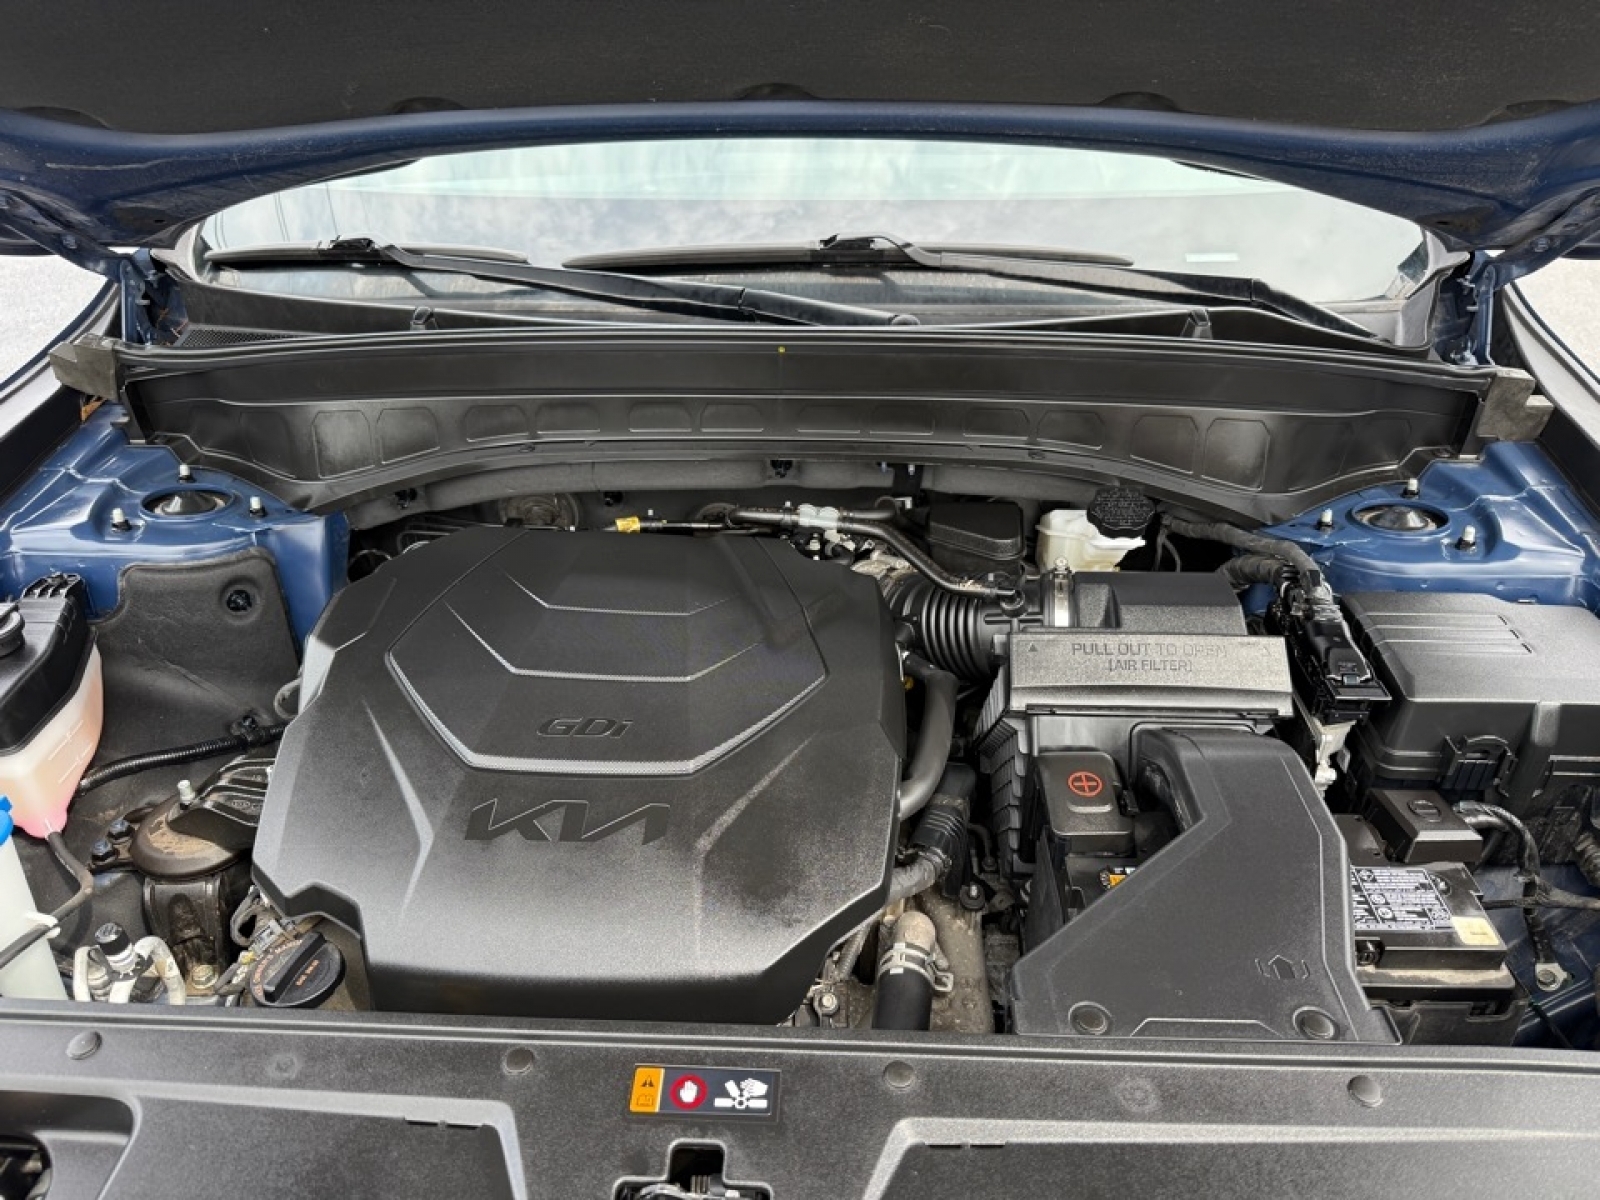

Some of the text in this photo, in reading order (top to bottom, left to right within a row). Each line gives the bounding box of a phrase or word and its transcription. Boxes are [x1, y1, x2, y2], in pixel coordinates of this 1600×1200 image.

[1071, 643, 1227, 658] PULL OUT TO OPEN
[537, 717, 633, 738] GDi
